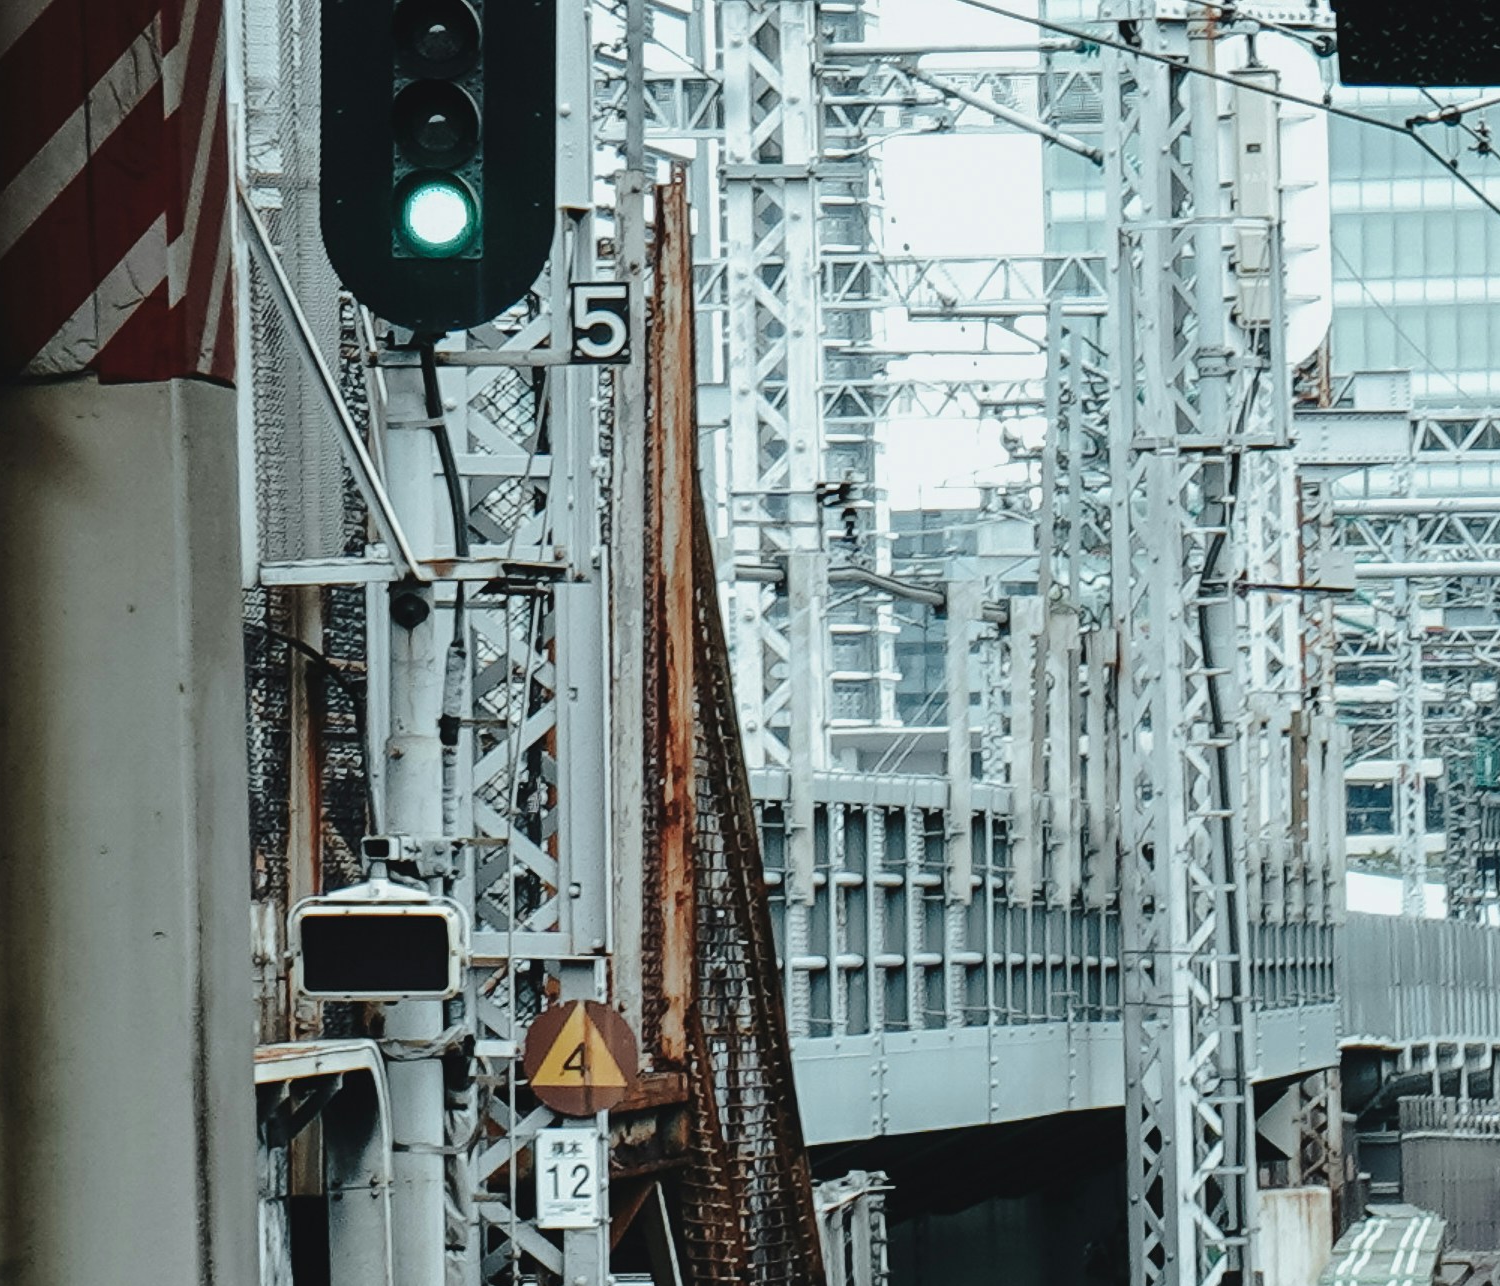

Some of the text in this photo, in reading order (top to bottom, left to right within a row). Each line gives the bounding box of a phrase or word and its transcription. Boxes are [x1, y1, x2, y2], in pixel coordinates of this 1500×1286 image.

[574, 285, 627, 358] 5
[561, 1041, 590, 1078] 4
[545, 1162, 592, 1201] 12
